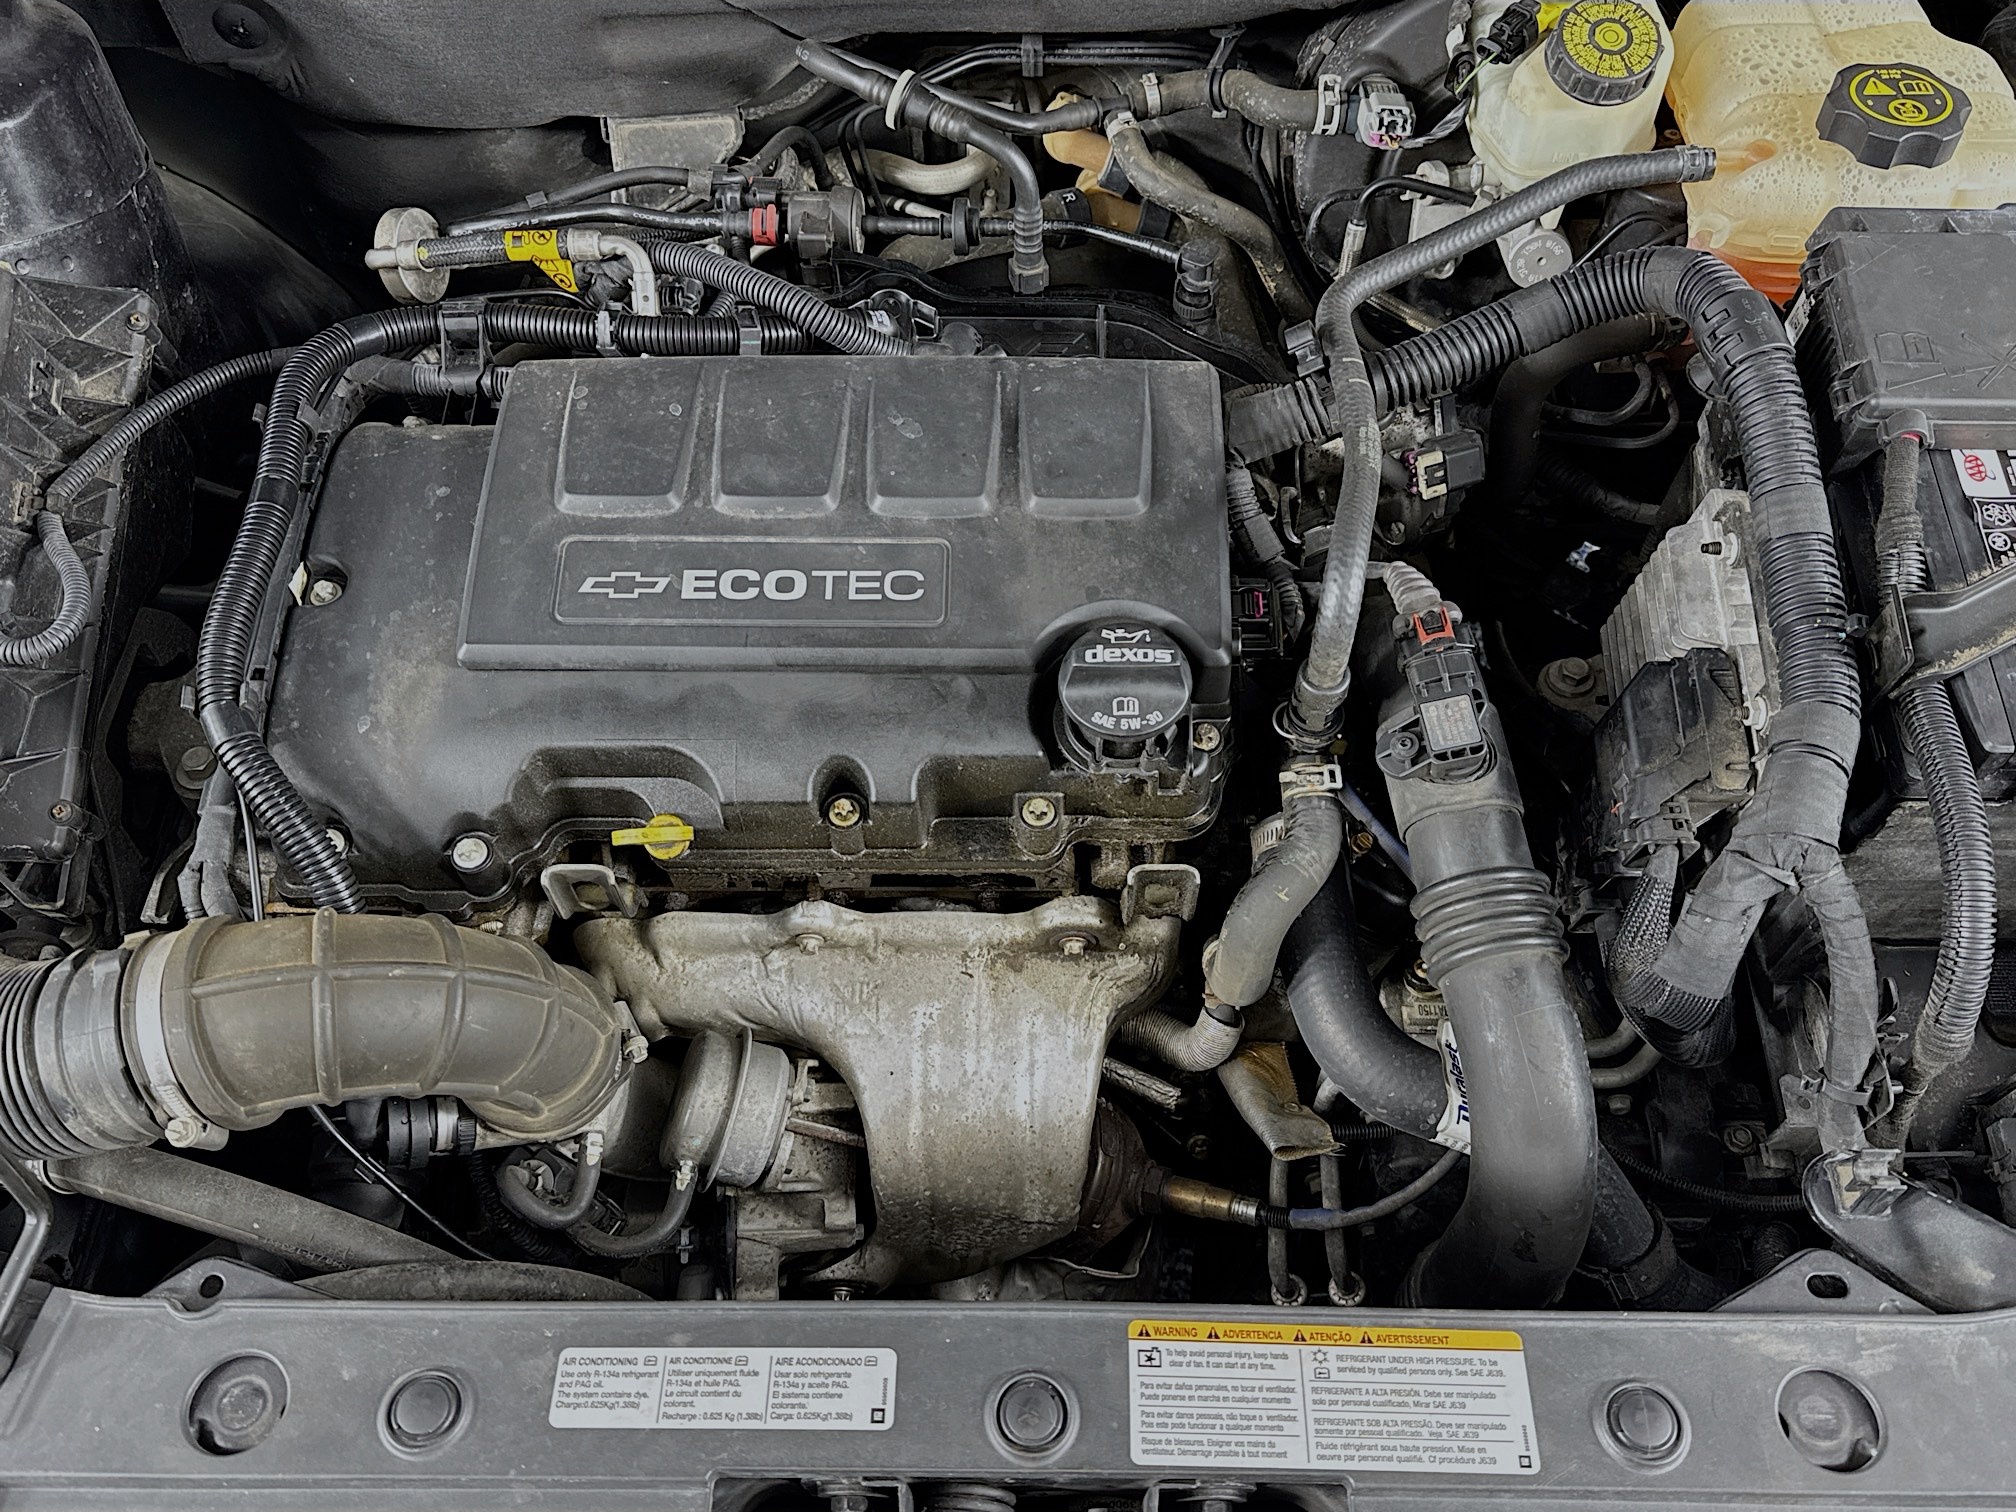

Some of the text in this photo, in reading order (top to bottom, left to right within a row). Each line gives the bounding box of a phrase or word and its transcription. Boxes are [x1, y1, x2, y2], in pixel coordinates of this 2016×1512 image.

[633, 212, 669, 223] COOPER
[681, 569, 925, 600] ECOTEC
[1084, 645, 1175, 663] dexos
[1091, 710, 1164, 730] SAE 5W-30
[1153, 1326, 1449, 1345] WARNING ADVERTENCIA ATENÇÃO AVERTISSEMENT
[562, 1357, 638, 1366] AIR CONDITIONING
[669, 1357, 681, 1365] AIR
[775, 1357, 862, 1366] AIRE ACONDICIONADO
[1336, 1354, 1386, 1363] REFRIGERANT
[1388, 1356, 1414, 1364] UNDER
[1416, 1357, 1434, 1365] HIGH
[577, 1371, 592, 1379] only
[558, 1390, 571, 1398] The
